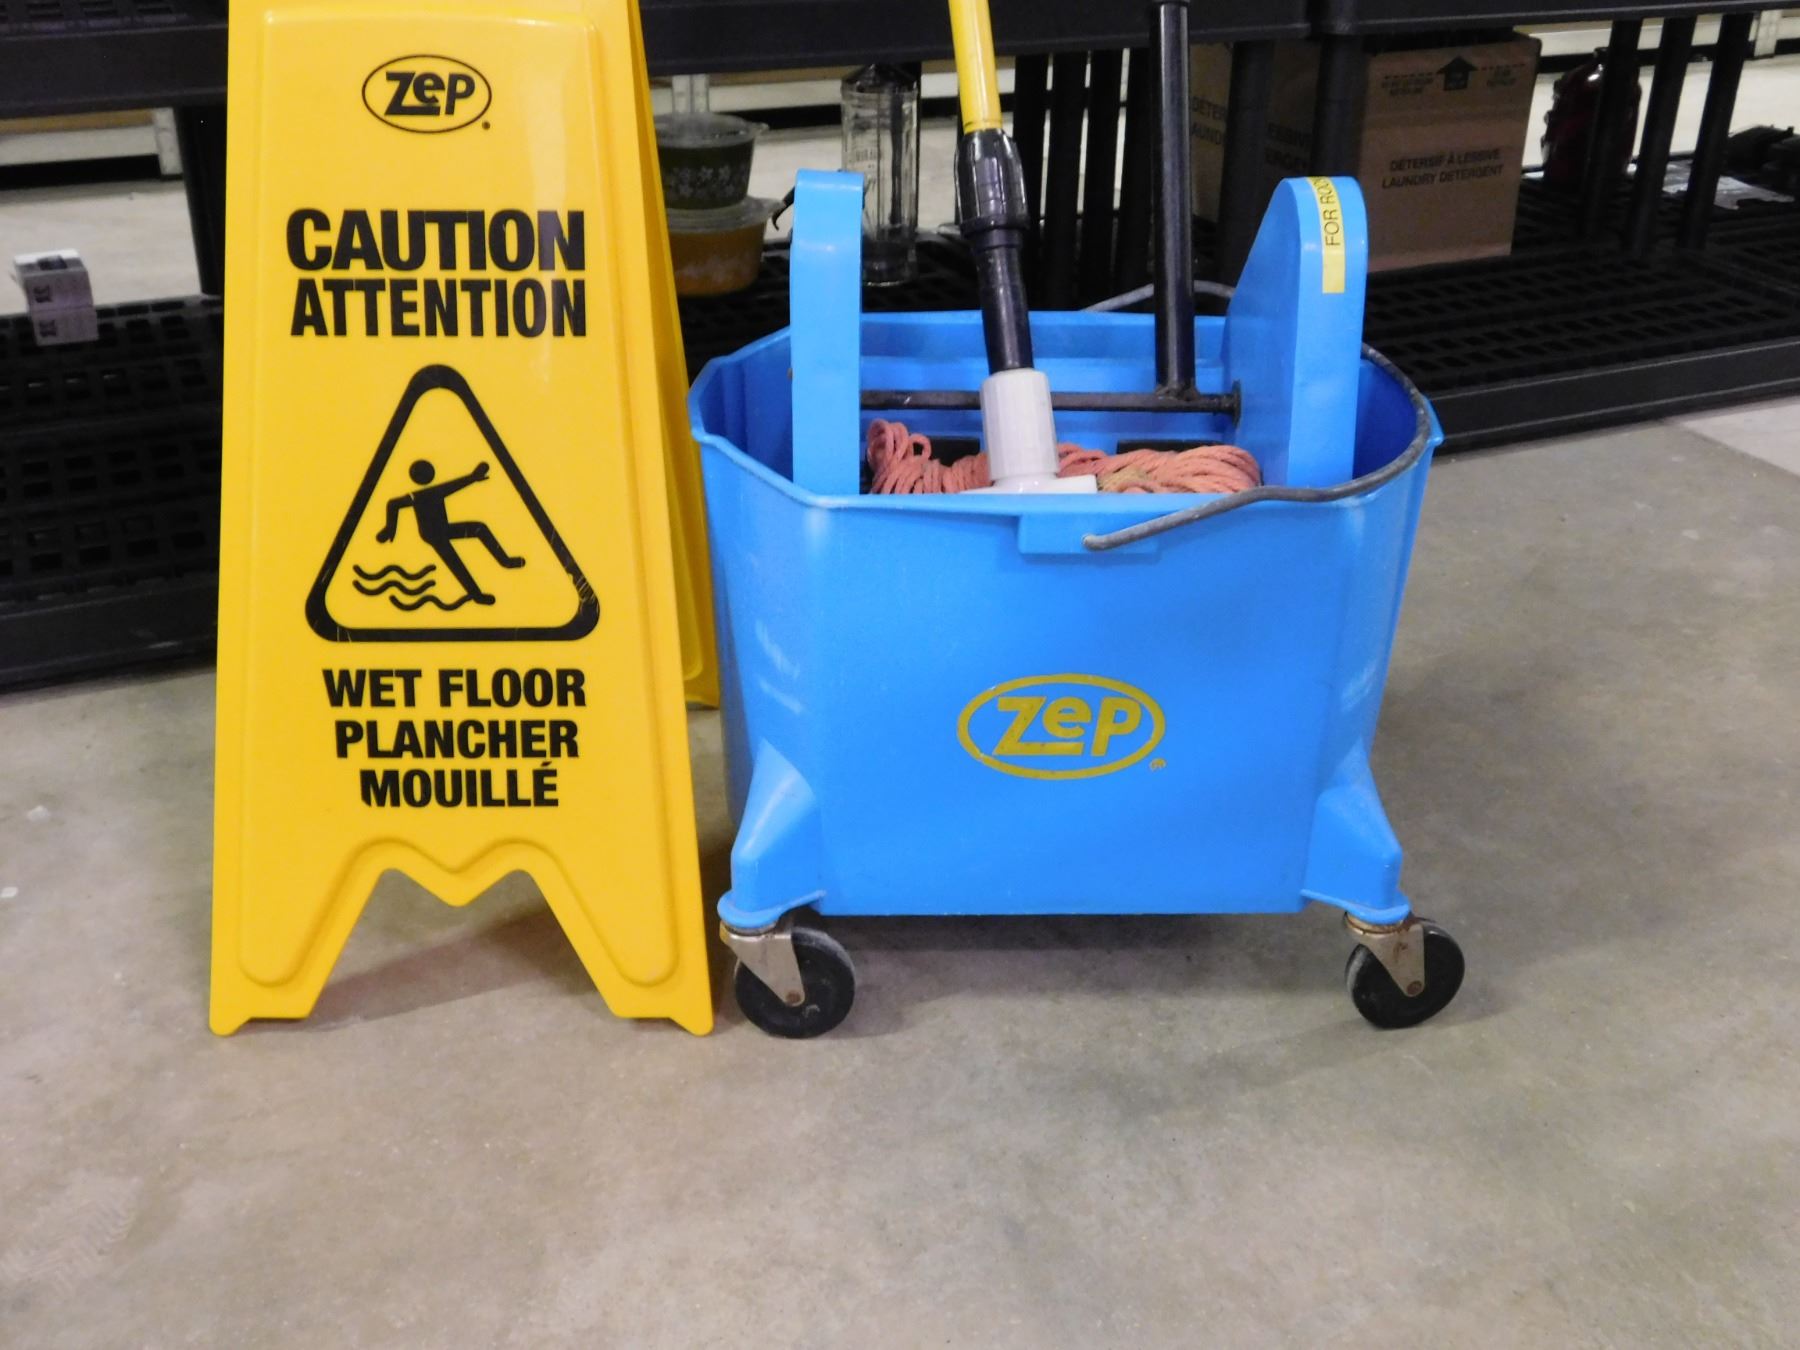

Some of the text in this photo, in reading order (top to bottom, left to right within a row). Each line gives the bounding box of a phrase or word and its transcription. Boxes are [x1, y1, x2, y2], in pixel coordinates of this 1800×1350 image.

[1381, 164, 1504, 189] LAUNDRY DETERGENT
[286, 208, 586, 272] CAUTION
[1323, 208, 1341, 246] FOR
[290, 278, 587, 338] ATTENTION
[322, 667, 586, 708] WET FLOOR
[335, 719, 579, 759] PLANCHER
[359, 761, 559, 808] MOUILLÉ
